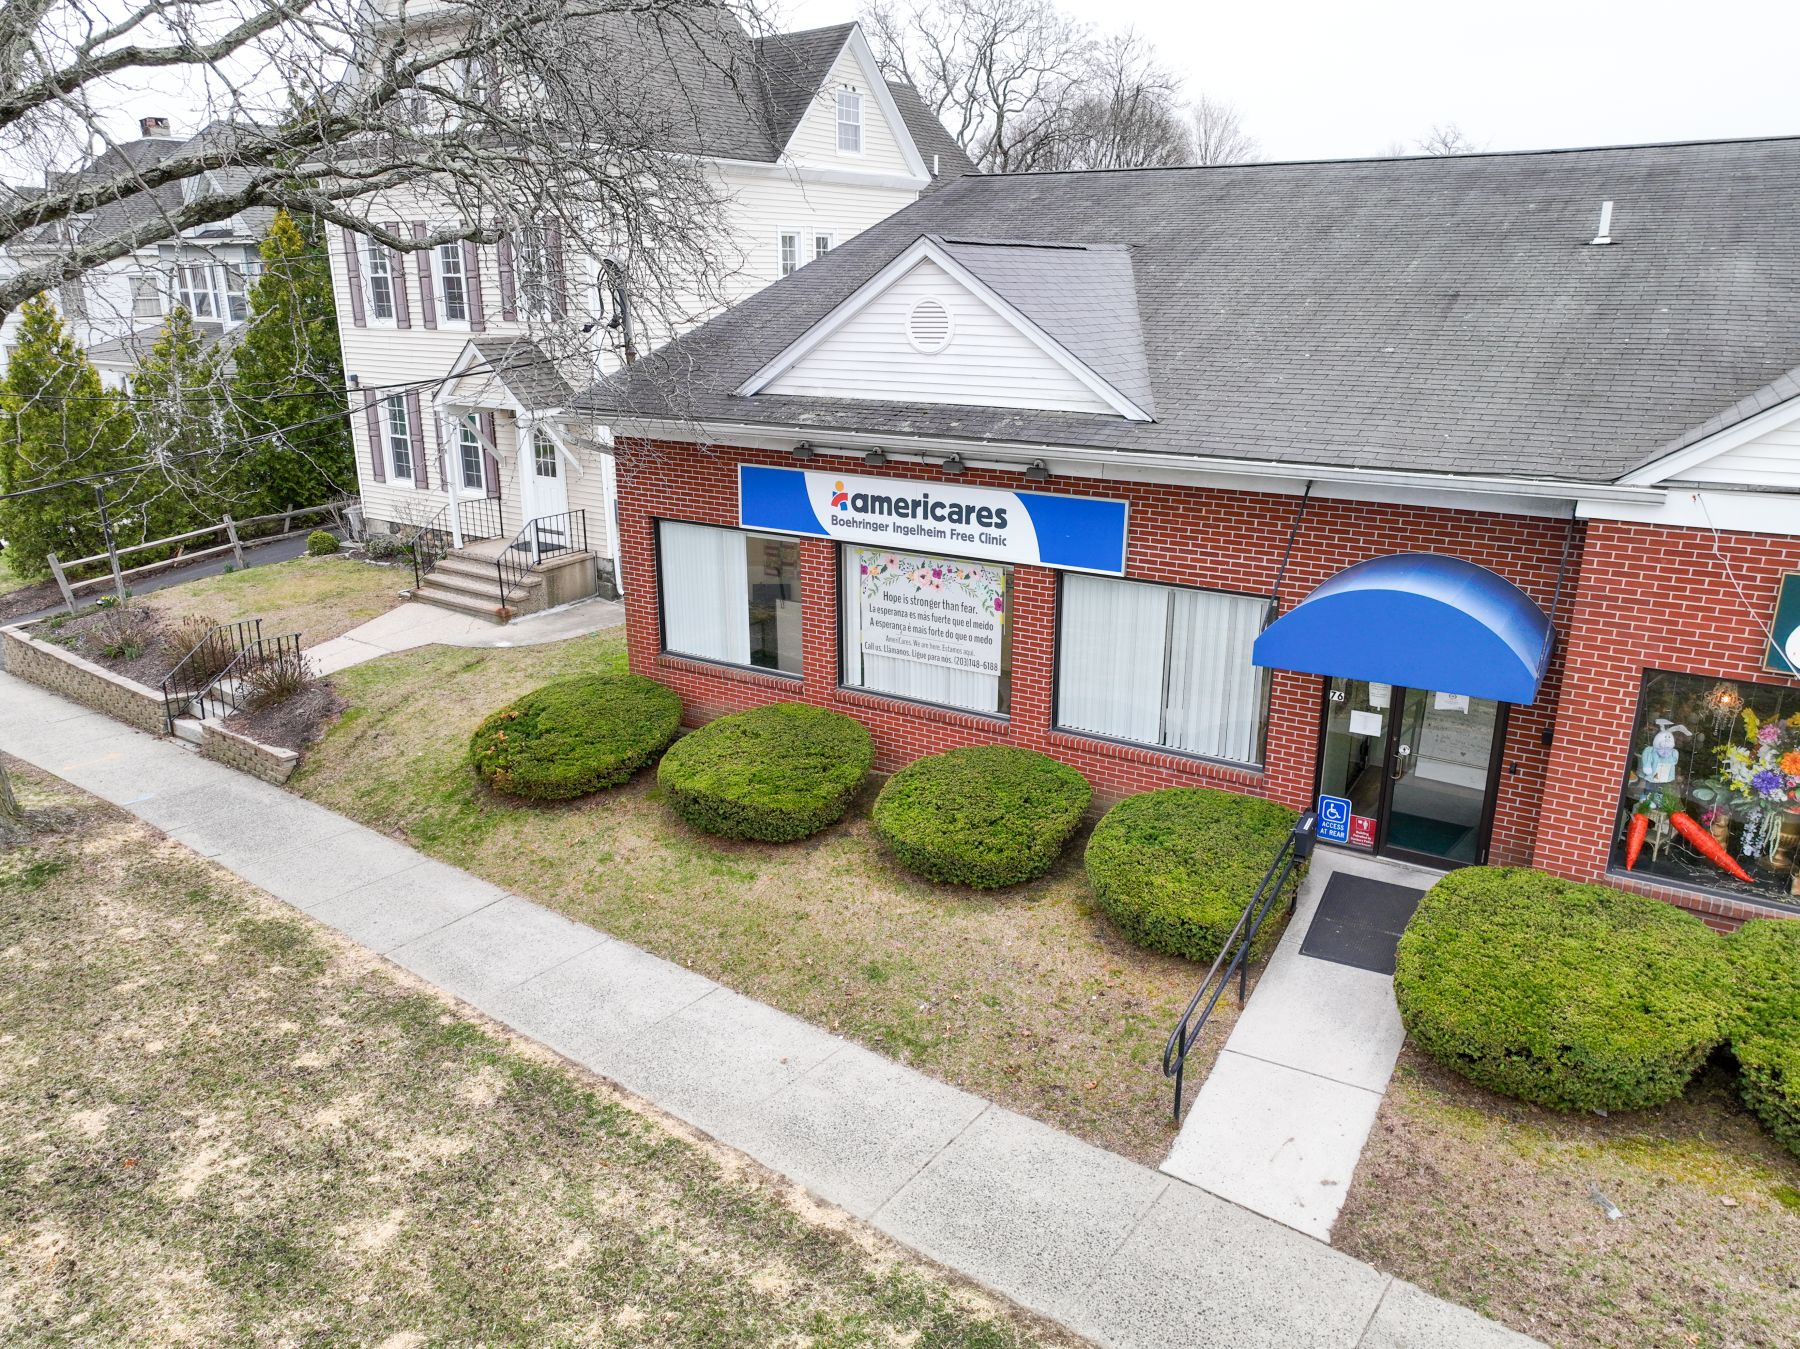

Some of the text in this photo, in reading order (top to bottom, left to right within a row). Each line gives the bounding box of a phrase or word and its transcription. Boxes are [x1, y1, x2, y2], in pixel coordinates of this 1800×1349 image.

[851, 493, 1007, 530] americares
[831, 514, 1007, 547] Boehringer Ingelheim Free Clinic
[883, 590, 978, 615] Hope is stronger than fear.
[869, 603, 876, 613] La
[877, 606, 908, 618] esperanza
[909, 611, 916, 619] es
[931, 613, 951, 625] fuerte
[952, 618, 965, 628] que
[965, 618, 972, 628] el
[870, 617, 875, 626] A
[912, 625, 928, 634] mais
[928, 626, 945, 637] forte
[945, 629, 954, 639] do
[955, 632, 968, 642] que
[968, 634, 973, 642] o
[973, 635, 993, 645] medo
[864, 641, 875, 650] Call
[911, 649, 927, 660] Ligue
[927, 653, 941, 662] para
[1331, 691, 1343, 700] 76
[1321, 821, 1344, 830] ACCESS
[1328, 830, 1345, 838] REAR
